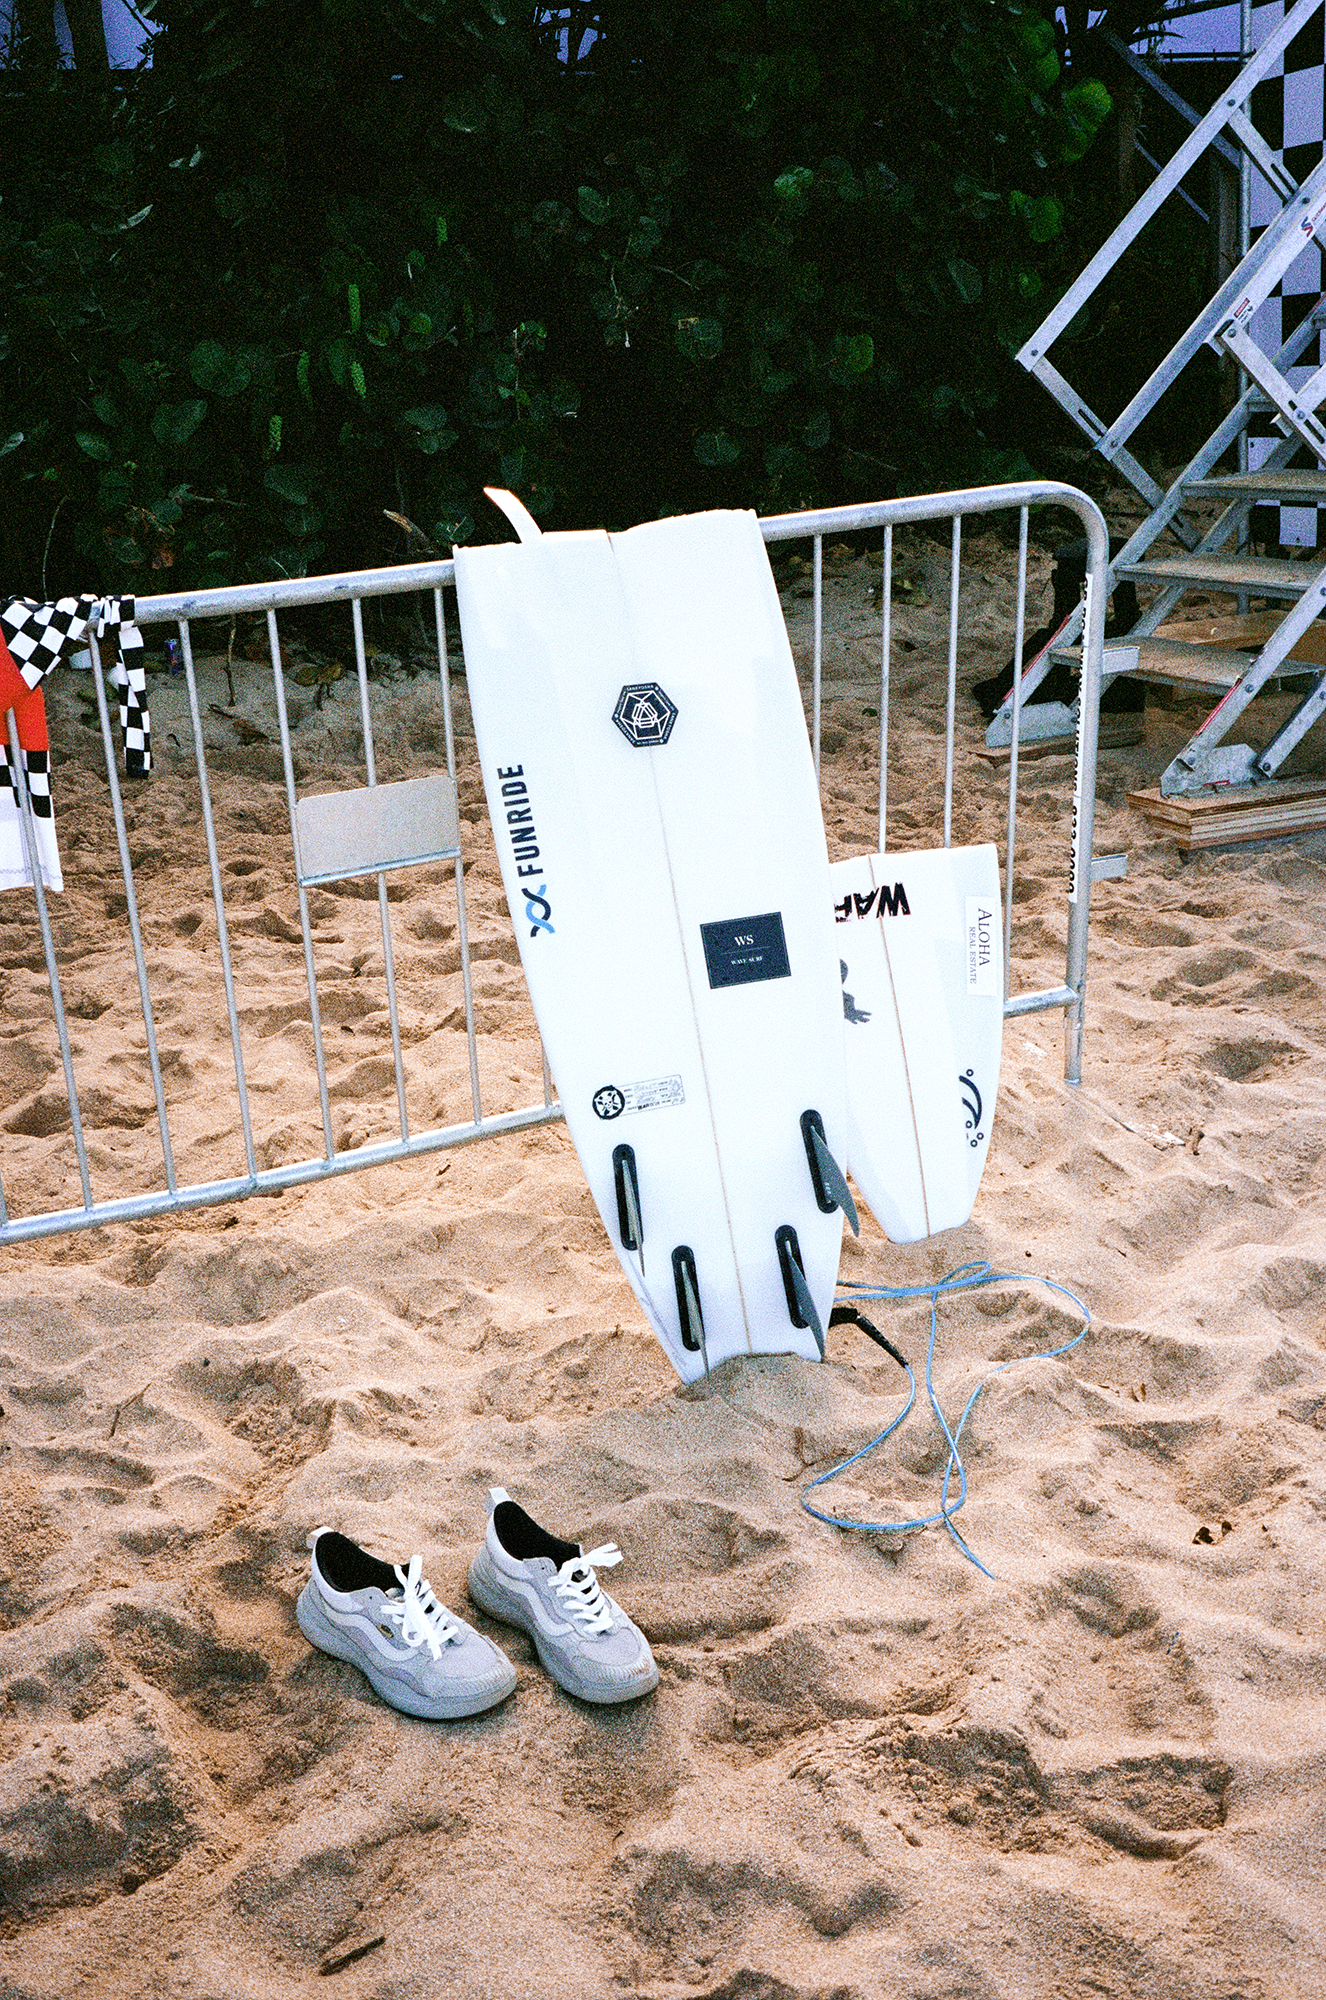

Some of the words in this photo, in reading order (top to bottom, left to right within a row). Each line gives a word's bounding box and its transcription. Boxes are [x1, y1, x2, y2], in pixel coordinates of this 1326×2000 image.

[497, 764, 544, 877] FUNRIDE
[734, 934, 754, 946] WS
[978, 908, 992, 966] ALOHA
[969, 951, 977, 984] ESTATE
